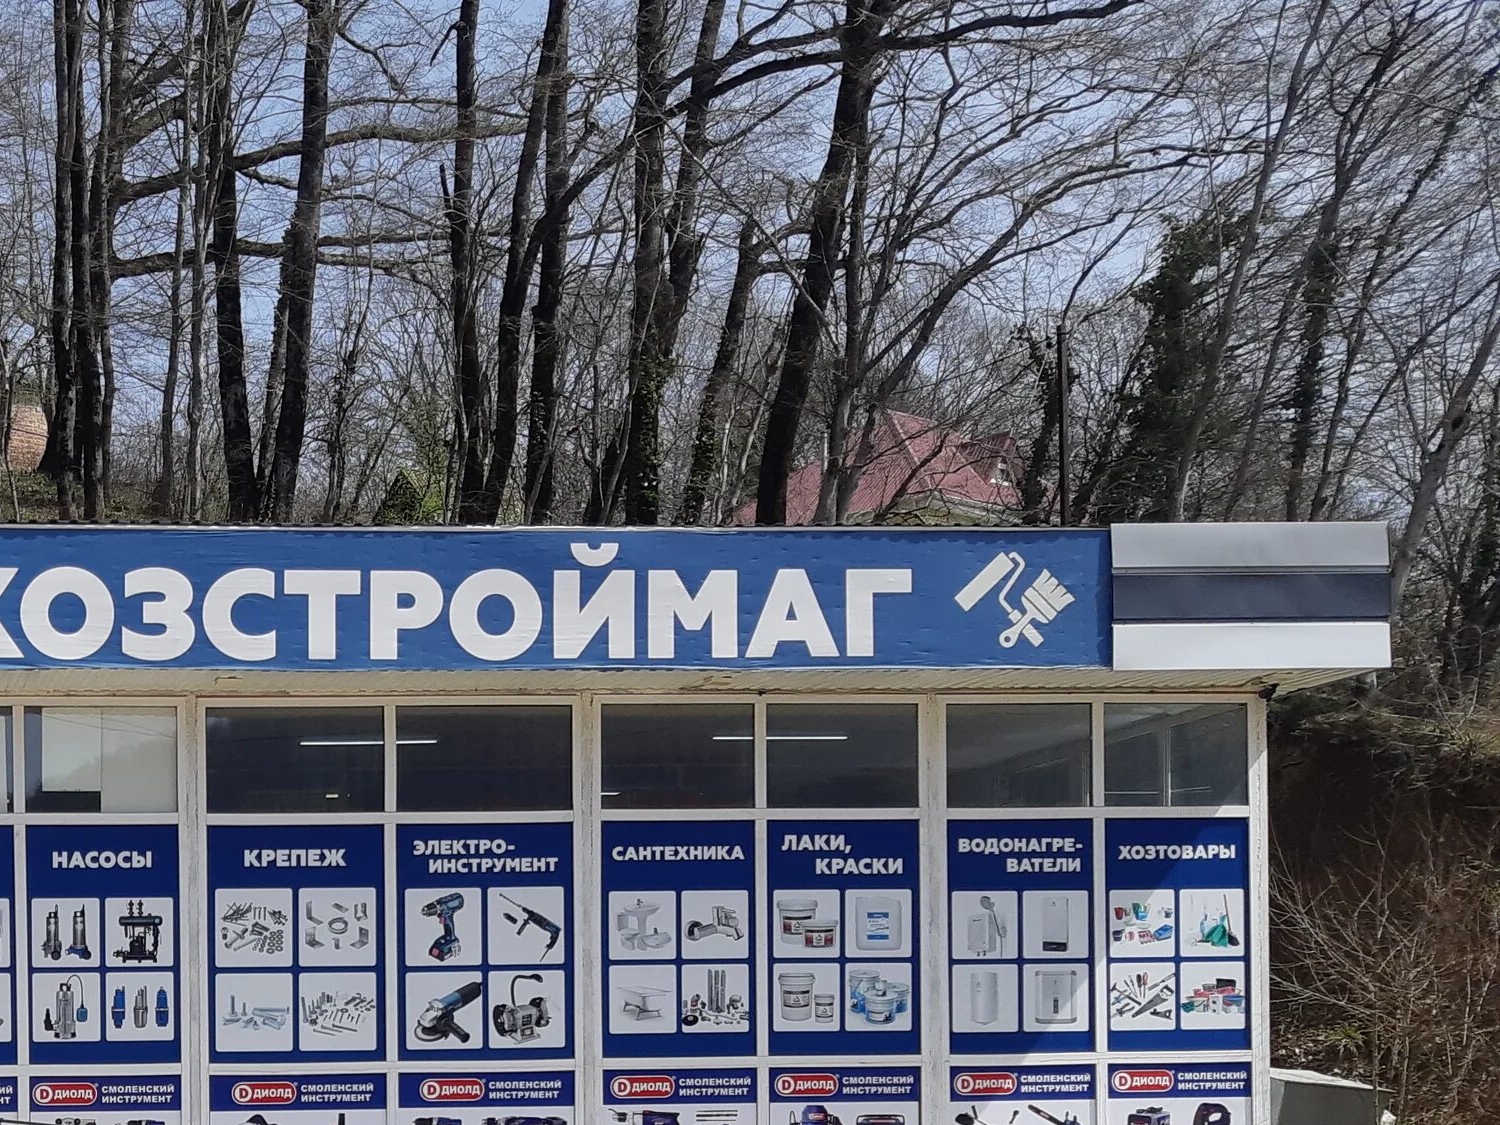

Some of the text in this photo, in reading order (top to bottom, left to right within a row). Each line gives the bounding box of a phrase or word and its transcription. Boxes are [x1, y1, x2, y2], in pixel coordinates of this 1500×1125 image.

[413, 838, 515, 856] ЭЛЕКТРО-
[781, 834, 852, 854] ЛАКИ,
[958, 838, 1083, 855] ВОДОНАГРЕ-
[243, 848, 347, 867] КРЕПЕЖ
[611, 845, 745, 861] САНТЕХНИКА
[1118, 844, 1236, 860] ХОЗТОВАРЫ
[52, 851, 152, 869] НАСОСЫ
[428, 857, 559, 874] ИНСТРУМЕНТ
[1006, 858, 1081, 873] ВАТЕЛИ
[815, 858, 903, 875] КРАСКИ
[842, 1075, 914, 1084] СМОЛЕНСКИЙ
[1021, 1073, 1091, 1082] СМОЛЕНСКИЙ
[1178, 1071, 1247, 1080] СМОЛЕНСКИЙ
[489, 1080, 562, 1089] СМОЛЕНСКИЙ
[679, 1077, 751, 1086] СМОЛЕНСКИЙ
[796, 1080, 834, 1091] ДИОЛД
[974, 1079, 1013, 1090] ДИОЛД
[1132, 1076, 1170, 1087] ДИОЛД
[1178, 1082, 1245, 1090] ИНСТРУМЕНТ
[102, 1084, 174, 1094] СМОЛЕНСКИЙ
[301, 1083, 374, 1092] СМОЛЕНСКИЙ
[441, 1085, 480, 1096] ДИОЛД
[632, 1082, 670, 1093] ДИОЛД
[679, 1088, 748, 1096] ИНСТРУМЕНТ
[842, 1086, 911, 1094] ИНСТРУМЕНТ
[1021, 1084, 1089, 1092] ИНСТРУМЕНТ
[54, 1089, 93, 1100] ДИОЛД
[254, 1088, 292, 1099] ДИОЛД
[301, 1094, 372, 1102] ИНСТРУМЕНТ
[489, 1091, 559, 1099] ИНСТРУМЕНТ
[102, 1095, 172, 1104] ИНСТРУМЕНТ
